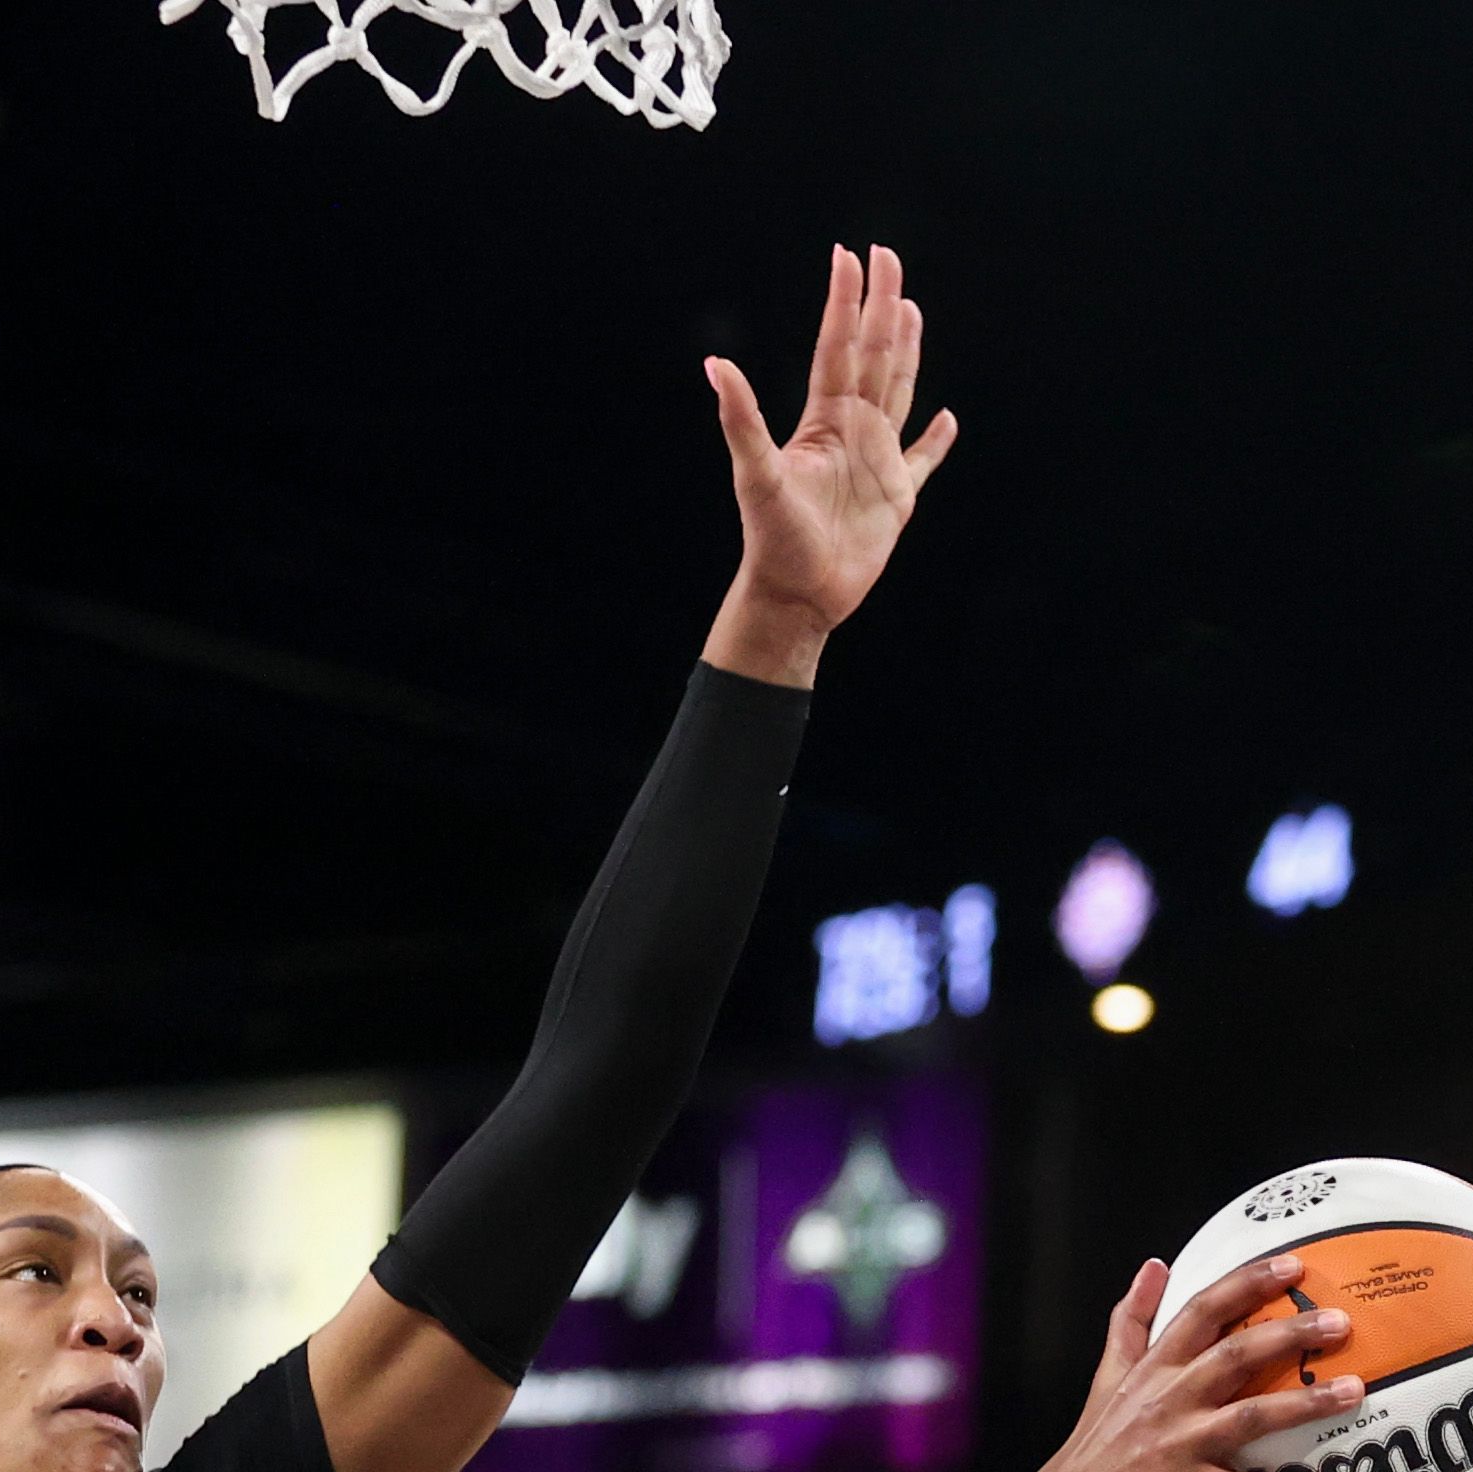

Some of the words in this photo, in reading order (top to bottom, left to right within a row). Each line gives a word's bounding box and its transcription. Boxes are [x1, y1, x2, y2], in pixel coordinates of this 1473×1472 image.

[1339, 1276, 1384, 1293] BALL
[1385, 1267, 1434, 1283] GAME
[1354, 1281, 1428, 1302] OFFICIAL
[1355, 1409, 1389, 1429] EVO
[1315, 1424, 1349, 1443] NXT
